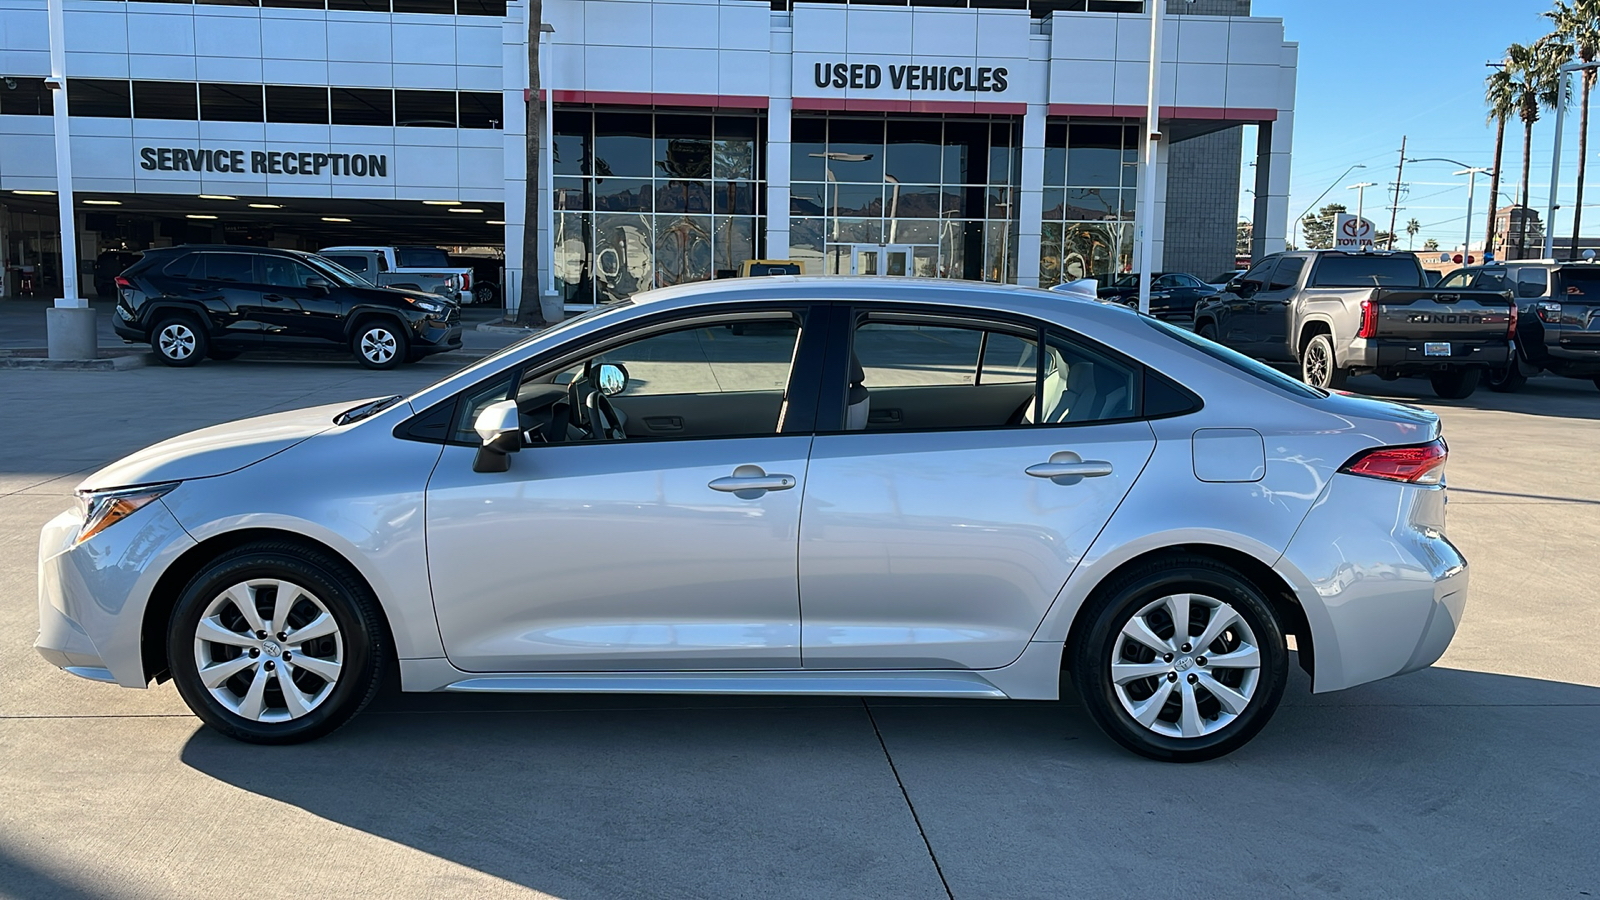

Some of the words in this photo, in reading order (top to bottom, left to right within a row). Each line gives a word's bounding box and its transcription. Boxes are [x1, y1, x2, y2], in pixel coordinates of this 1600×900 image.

[814, 62, 882, 89] USED
[888, 64, 1008, 93] VEHICLES
[140, 147, 245, 173] SERVICE
[251, 150, 387, 177] RECEPTION
[1407, 314, 1482, 324] TUNDRA
